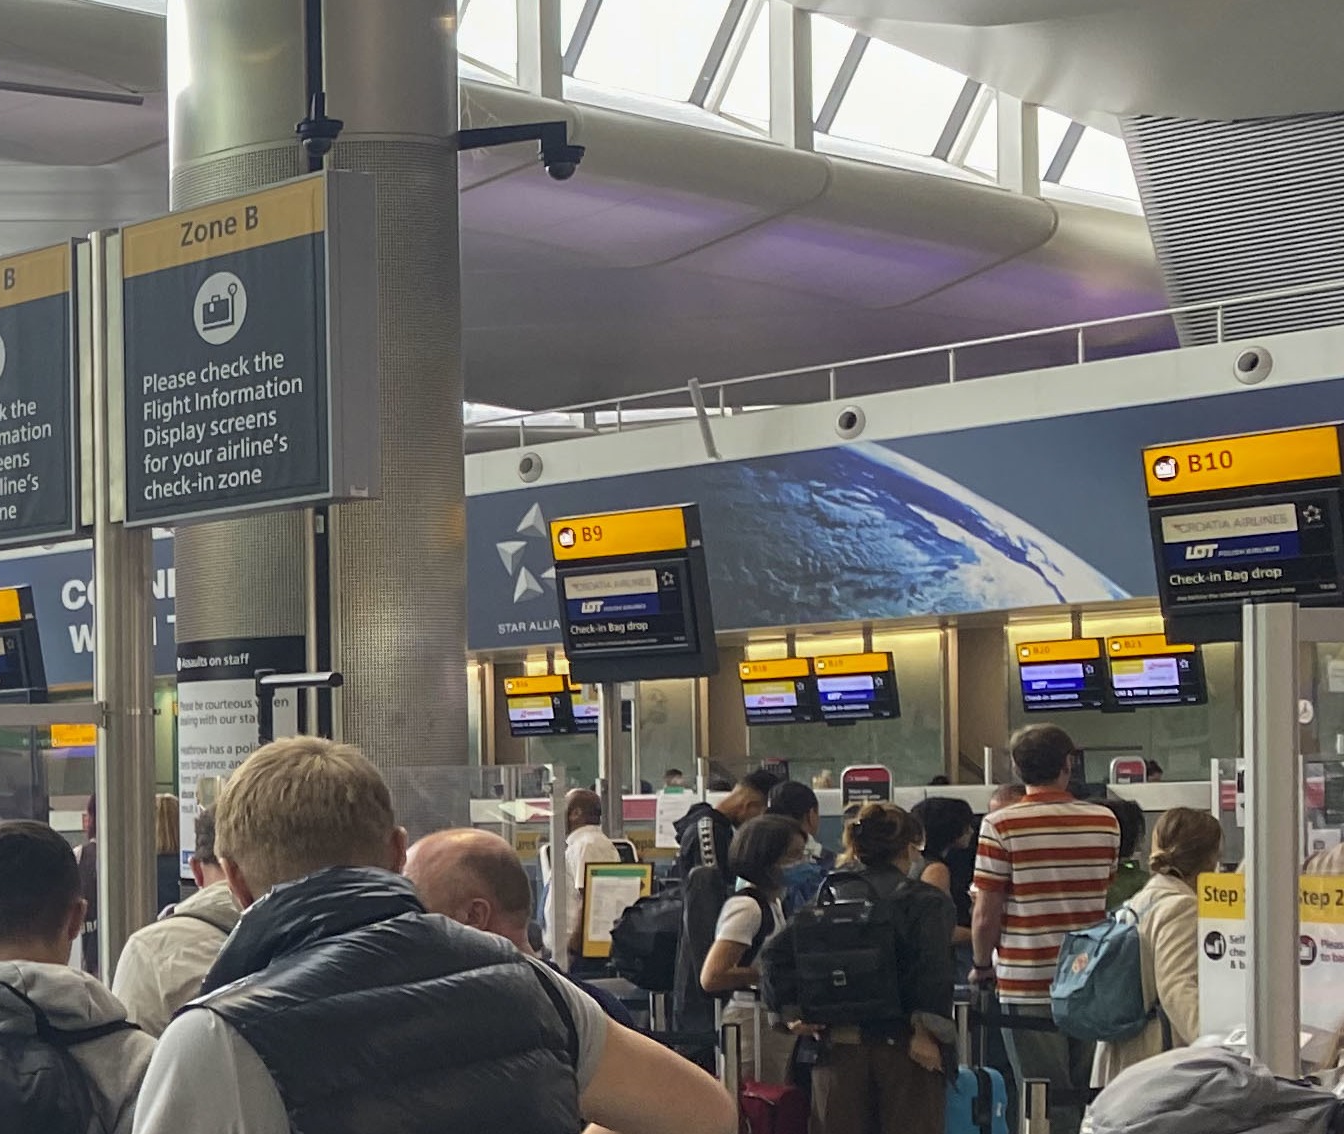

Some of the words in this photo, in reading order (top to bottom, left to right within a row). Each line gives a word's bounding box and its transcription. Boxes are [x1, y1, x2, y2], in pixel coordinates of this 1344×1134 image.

[181, 215, 237, 247] Zone
[245, 205, 259, 231] B
[4, 267, 17, 290] B
[143, 370, 196, 395] Please
[200, 357, 250, 384] check
[254, 351, 285, 372] the
[143, 394, 191, 422] Flight
[195, 374, 303, 412] Information
[11, 399, 37, 420] the
[143, 420, 207, 448] Display
[210, 408, 278, 435] screens
[143, 451, 169, 475] for
[173, 442, 213, 472] your
[216, 433, 289, 466] airline's
[1188, 450, 1233, 474] B10
[144, 475, 215, 501] check-in
[218, 469, 263, 491] zone
[581, 525, 603, 543] B9
[1185, 543, 1219, 560] LOT
[1169, 570, 1222, 587] Check-in
[1224, 568, 1249, 583] Bag
[1251, 566, 1283, 582] drop
[581, 600, 604, 614] LOT
[498, 622, 526, 635] STAR
[529, 619, 561, 632] ALLIA
[570, 624, 607, 635] Check-in
[608, 622, 626, 634] Bag
[627, 620, 649, 632] drop
[181, 656, 208, 669] Assaults
[208, 656, 221, 667] on
[223, 652, 250, 666] staff
[194, 701, 204, 711] be
[204, 698, 253, 711] courteous
[199, 715, 218, 726] with
[219, 714, 237, 725] our
[209, 744, 225, 755] has
[226, 747, 233, 755] a
[1204, 885, 1238, 907] Step
[1335, 889, 1344, 907] 2
[1229, 935, 1246, 945] Self
